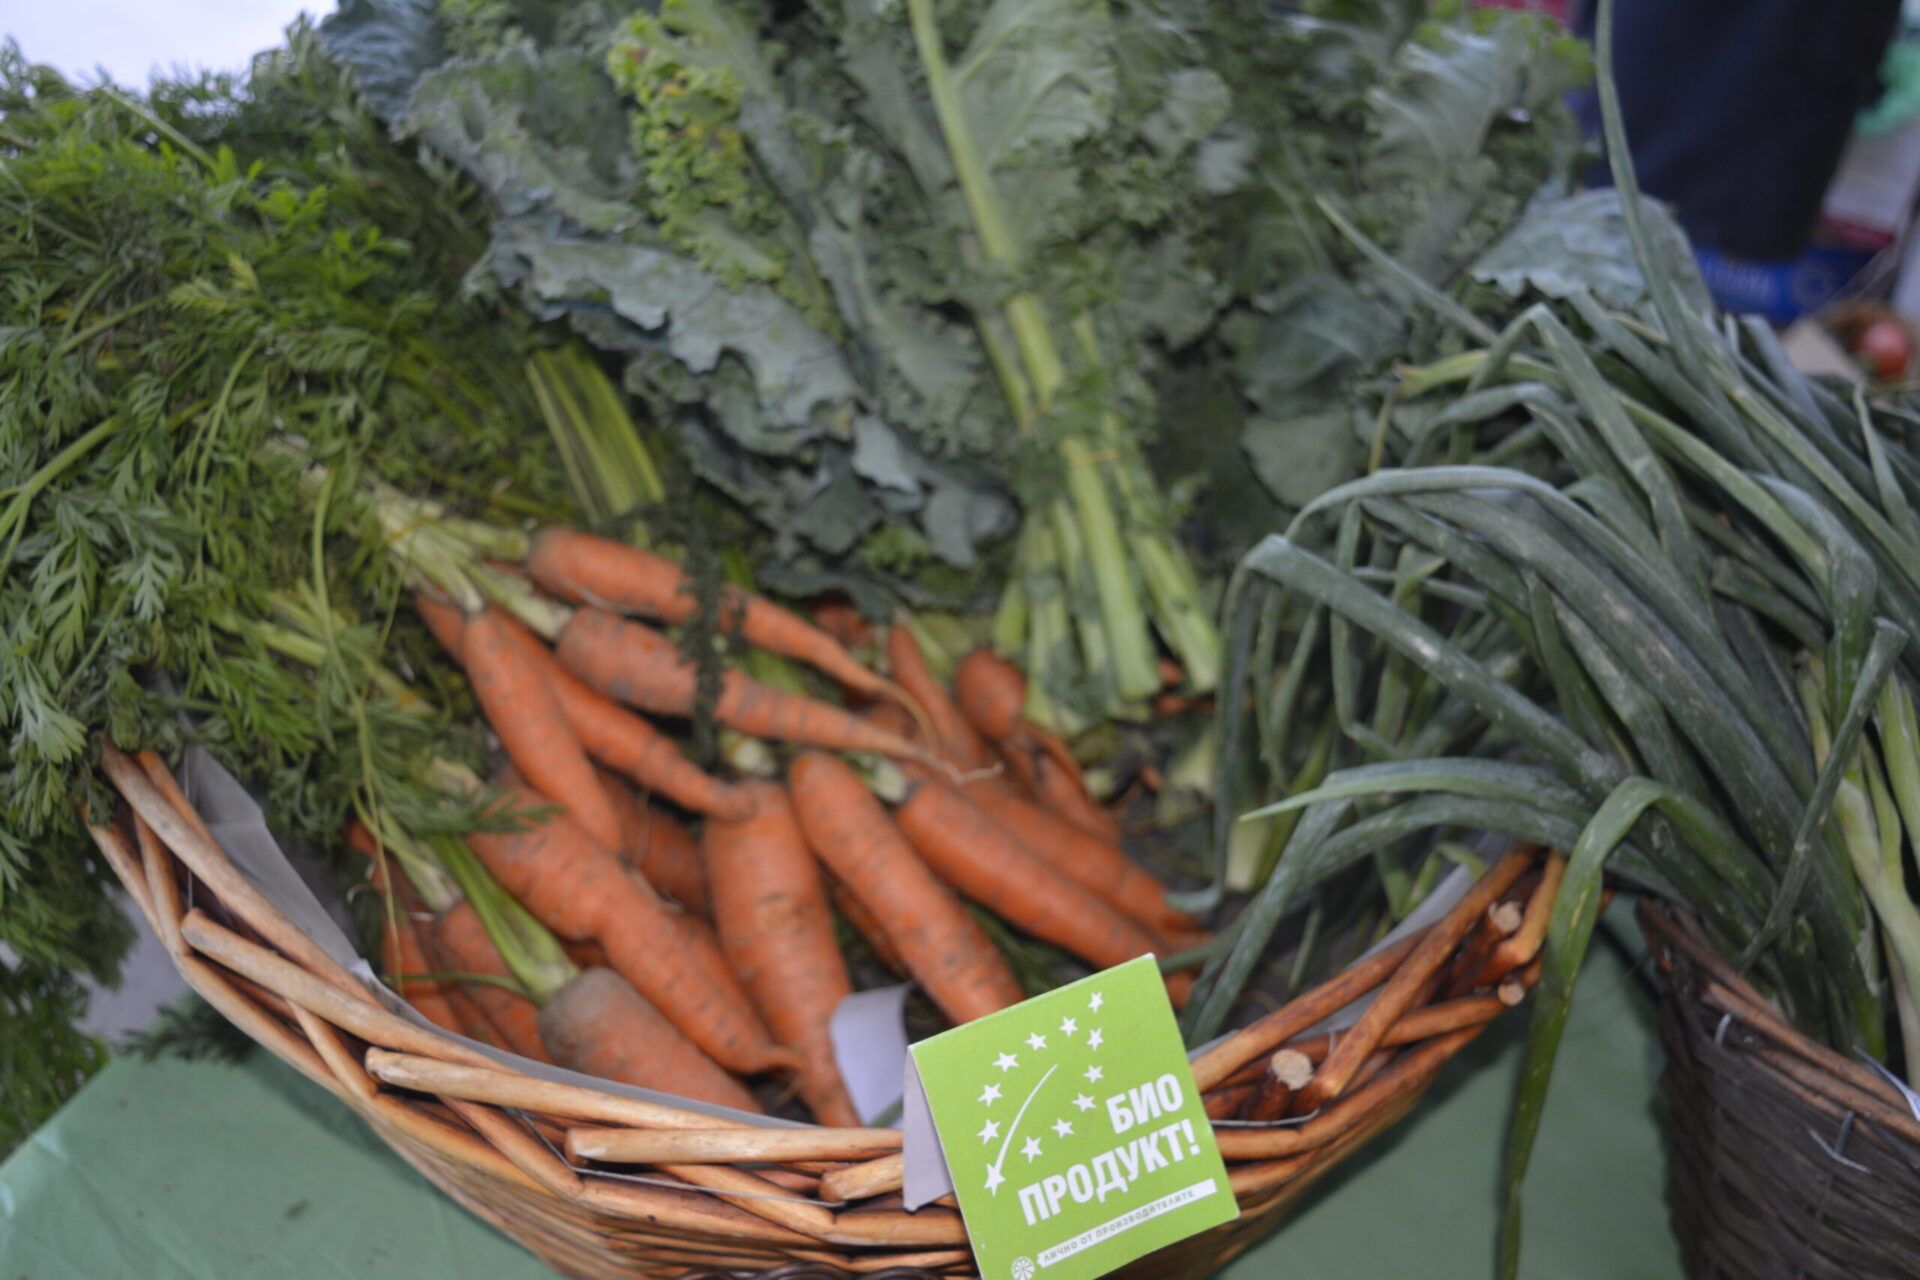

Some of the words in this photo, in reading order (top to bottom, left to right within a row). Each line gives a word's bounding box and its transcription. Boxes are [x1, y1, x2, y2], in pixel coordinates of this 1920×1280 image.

[1105, 1073, 1184, 1134] БИО
[1018, 1118, 1201, 1227] ПРОДУКТ!
[1043, 1241, 1078, 1262] ЛИЧНО
[1080, 1233, 1093, 1245] ОТ
[1096, 1189, 1194, 1237] ПРОИЗВОДИТЕЛИТЕ
